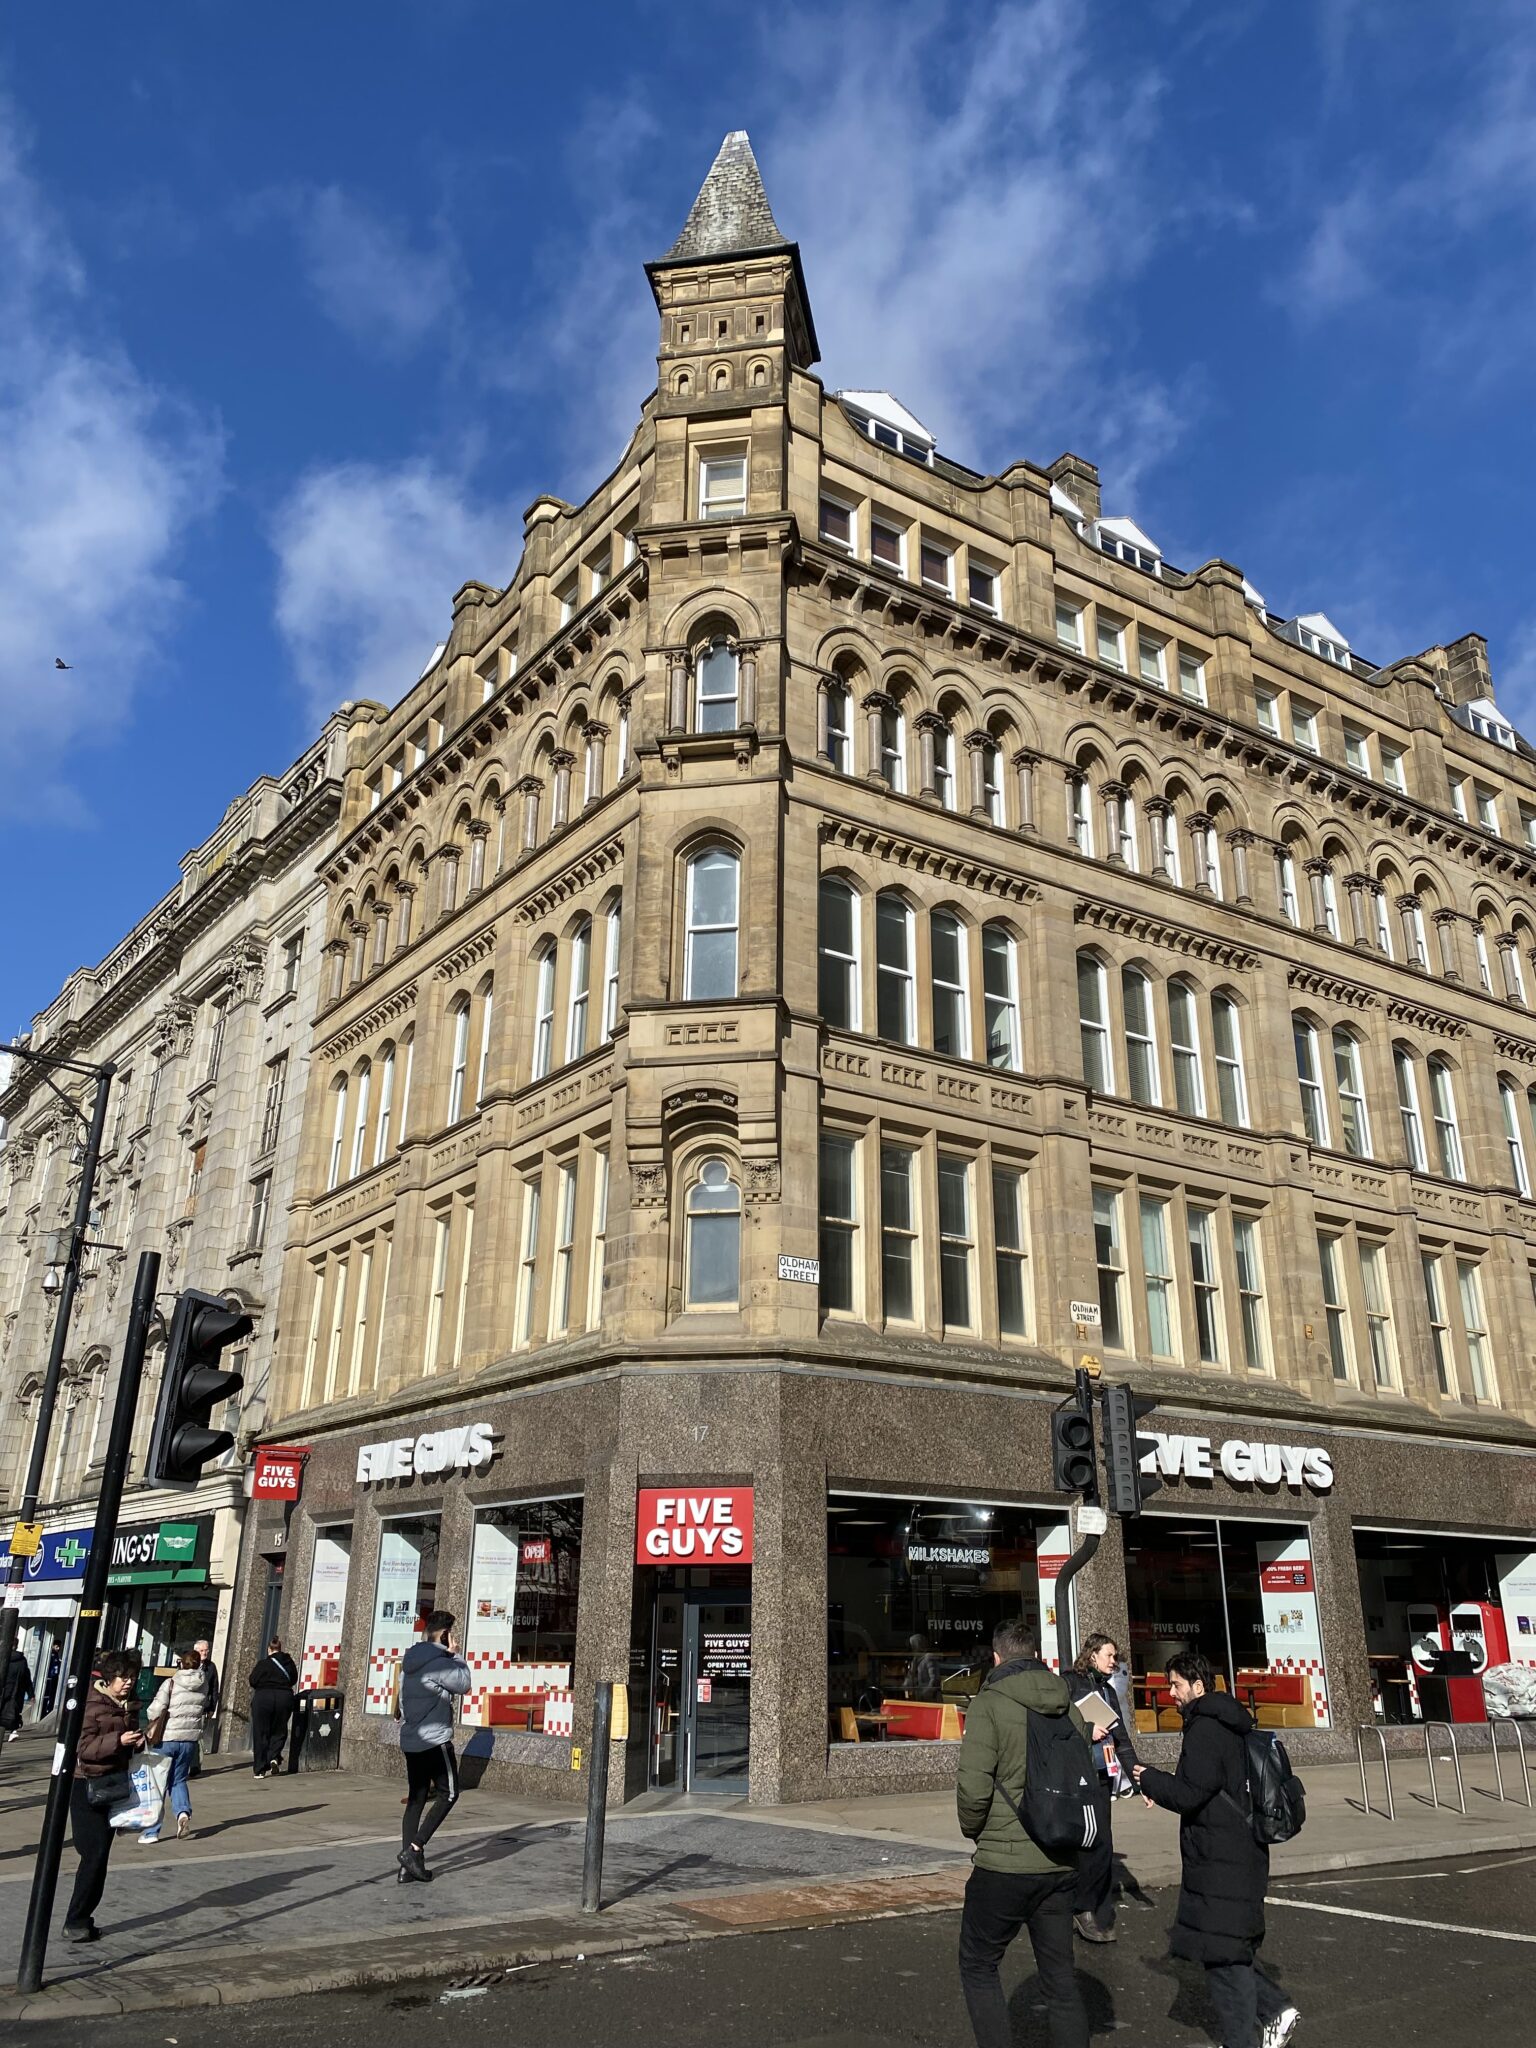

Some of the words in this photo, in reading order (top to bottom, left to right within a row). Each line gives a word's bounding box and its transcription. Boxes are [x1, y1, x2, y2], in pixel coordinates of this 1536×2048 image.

[779, 1256, 819, 1271] OLDHAM
[782, 1268, 817, 1282] STREET
[1072, 1303, 1099, 1315] OLDHAM
[1076, 1313, 1096, 1322] STREET
[691, 1425, 708, 1442] 17
[356, 1438, 415, 1483] FIVE
[414, 1422, 494, 1475] GUYS
[1136, 1431, 1214, 1478] IVE
[1220, 1439, 1334, 1489] GUYS
[263, 1465, 294, 1477] FIVE
[258, 1477, 296, 1488] GUYS
[656, 1497, 733, 1526] FIVE
[274, 1533, 282, 1547] 15
[645, 1527, 743, 1557] GUYS
[525, 1545, 545, 1560] OPEN
[908, 1546, 990, 1564] MILKSHAKES
[522, 1616, 540, 1626] GUYS
[928, 1619, 952, 1630] FIVE
[954, 1620, 984, 1631] GUYS
[1153, 1623, 1174, 1633] FIVE
[1176, 1623, 1200, 1633] GUYS
[1252, 1624, 1272, 1634] FIVE
[1273, 1624, 1296, 1634] GUYS
[705, 1640, 724, 1648] FIVE
[726, 1640, 750, 1648] GUYS
